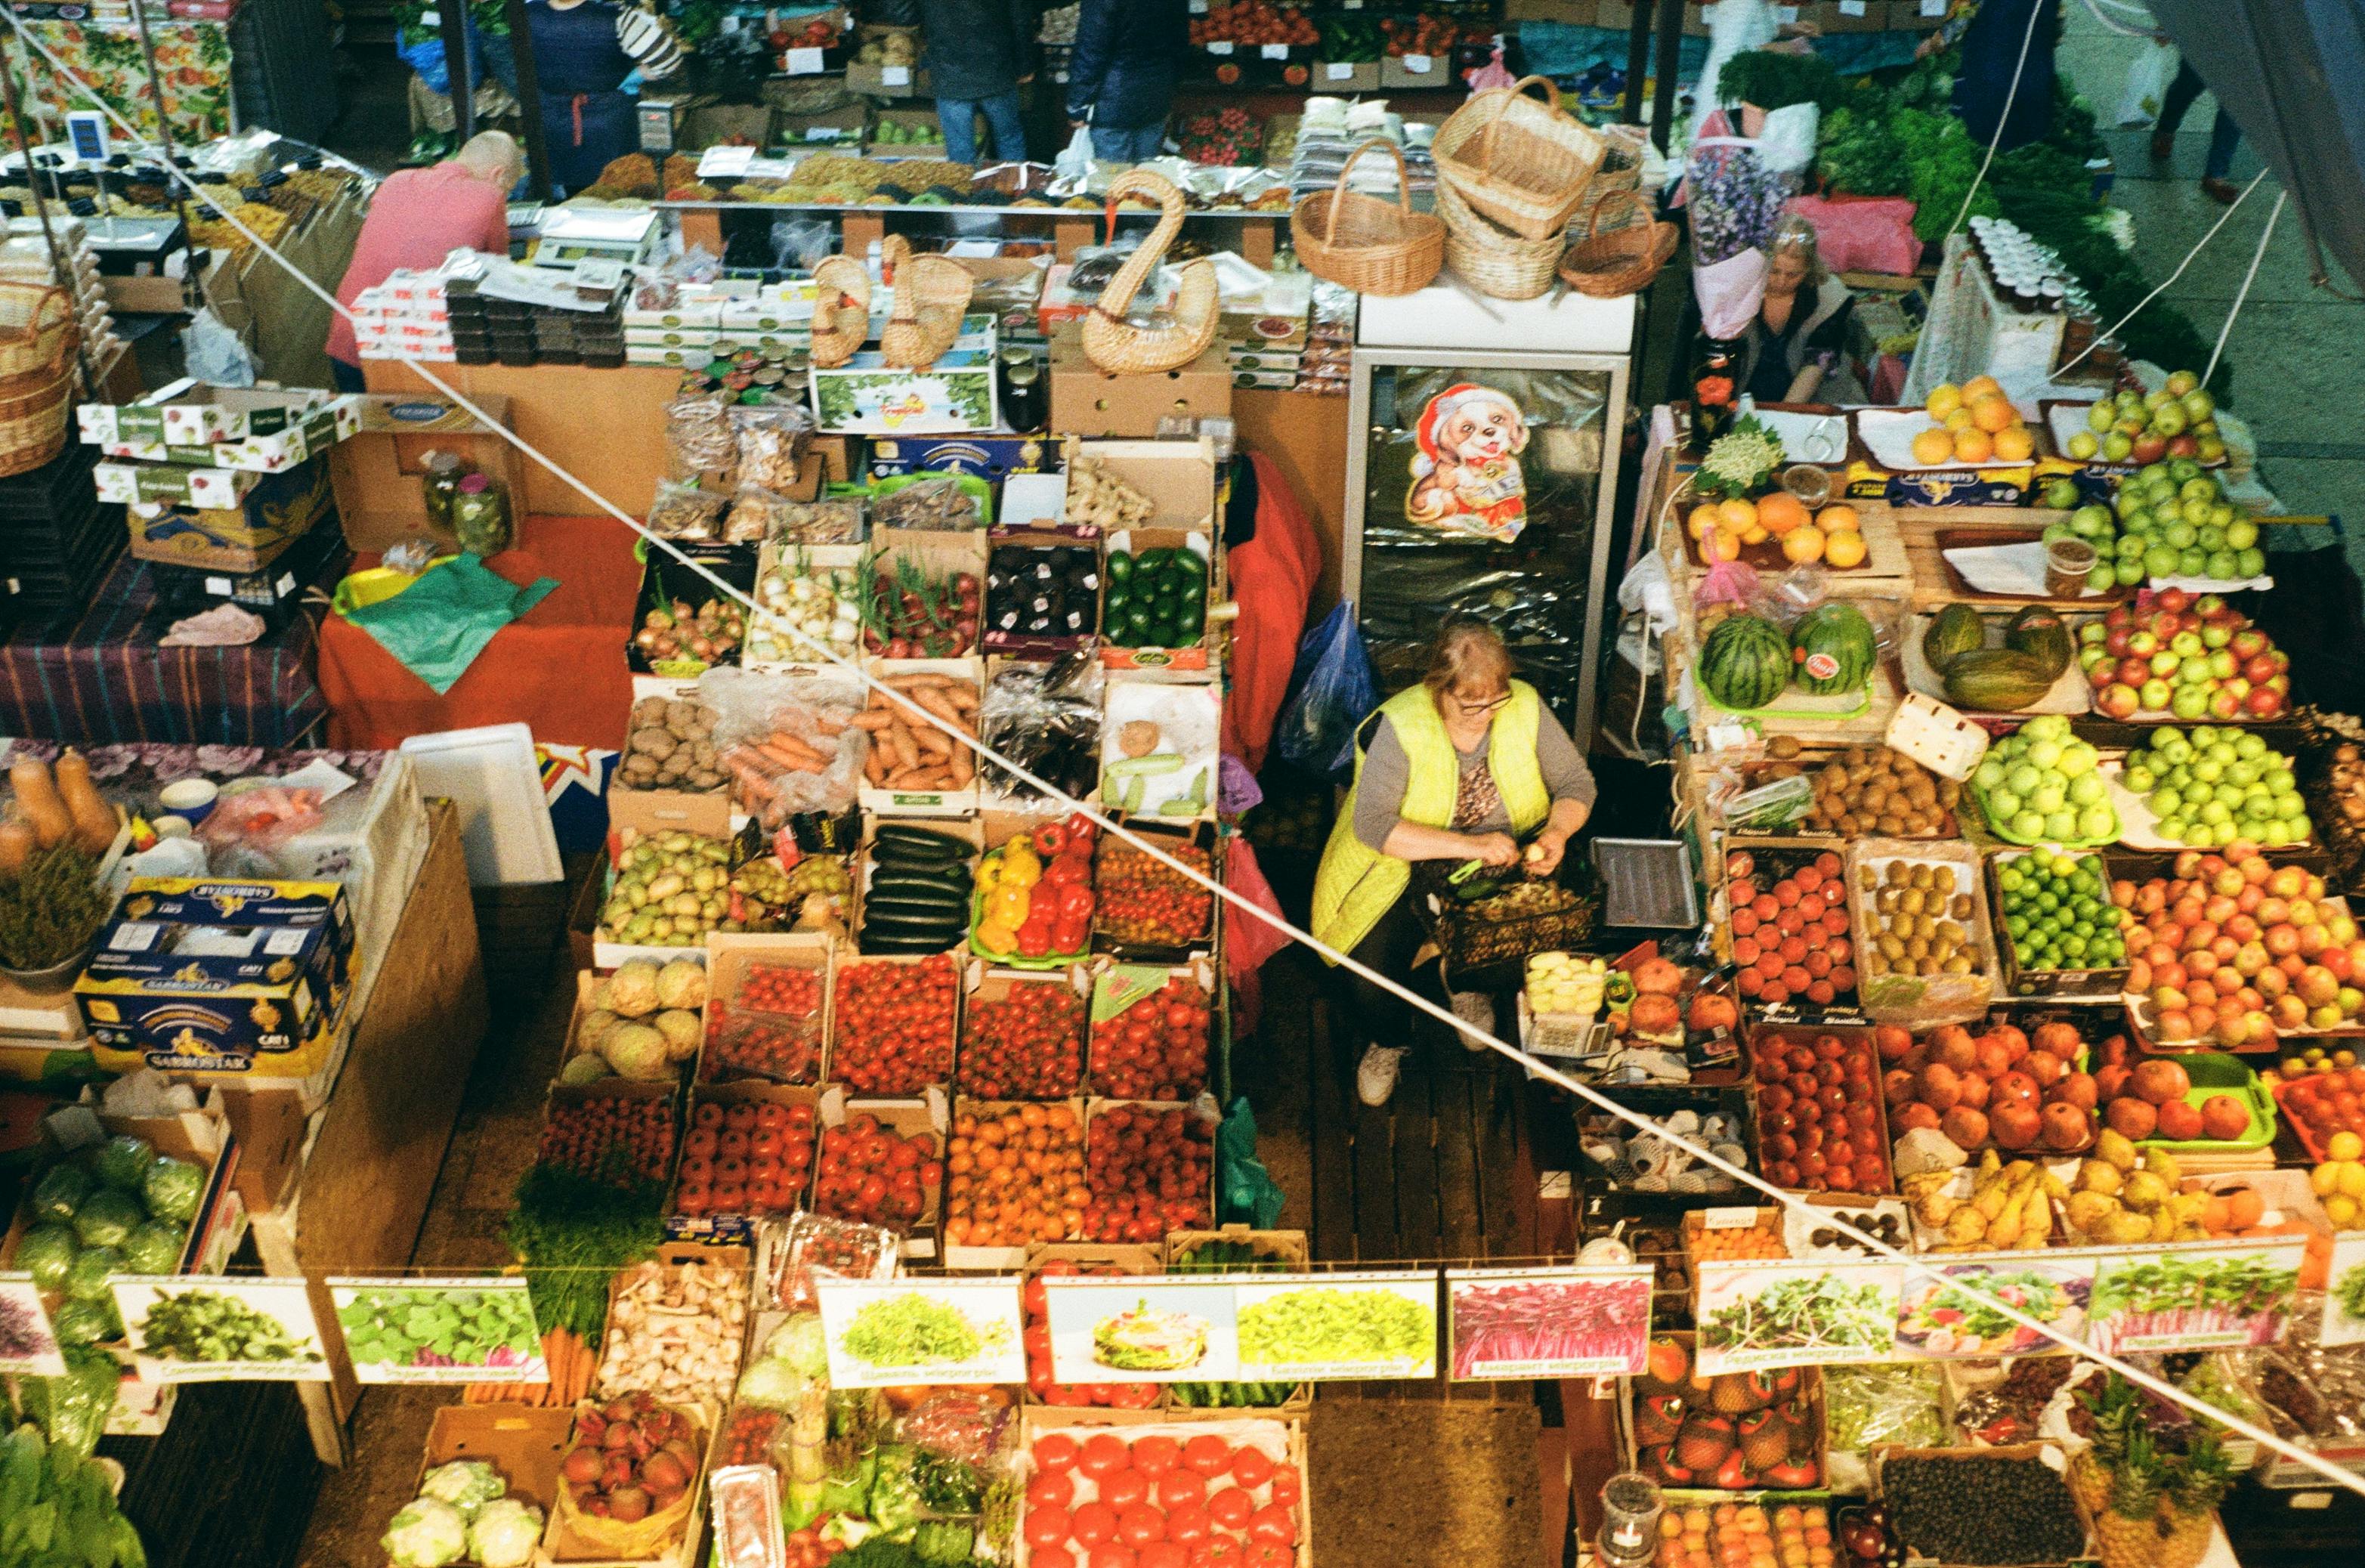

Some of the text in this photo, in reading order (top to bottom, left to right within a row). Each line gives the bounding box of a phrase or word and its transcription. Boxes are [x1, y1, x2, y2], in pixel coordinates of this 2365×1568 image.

[1792, 1347, 1866, 1360] мікрогрін
[1479, 1359, 1622, 1374] Амарант мікрогрін
